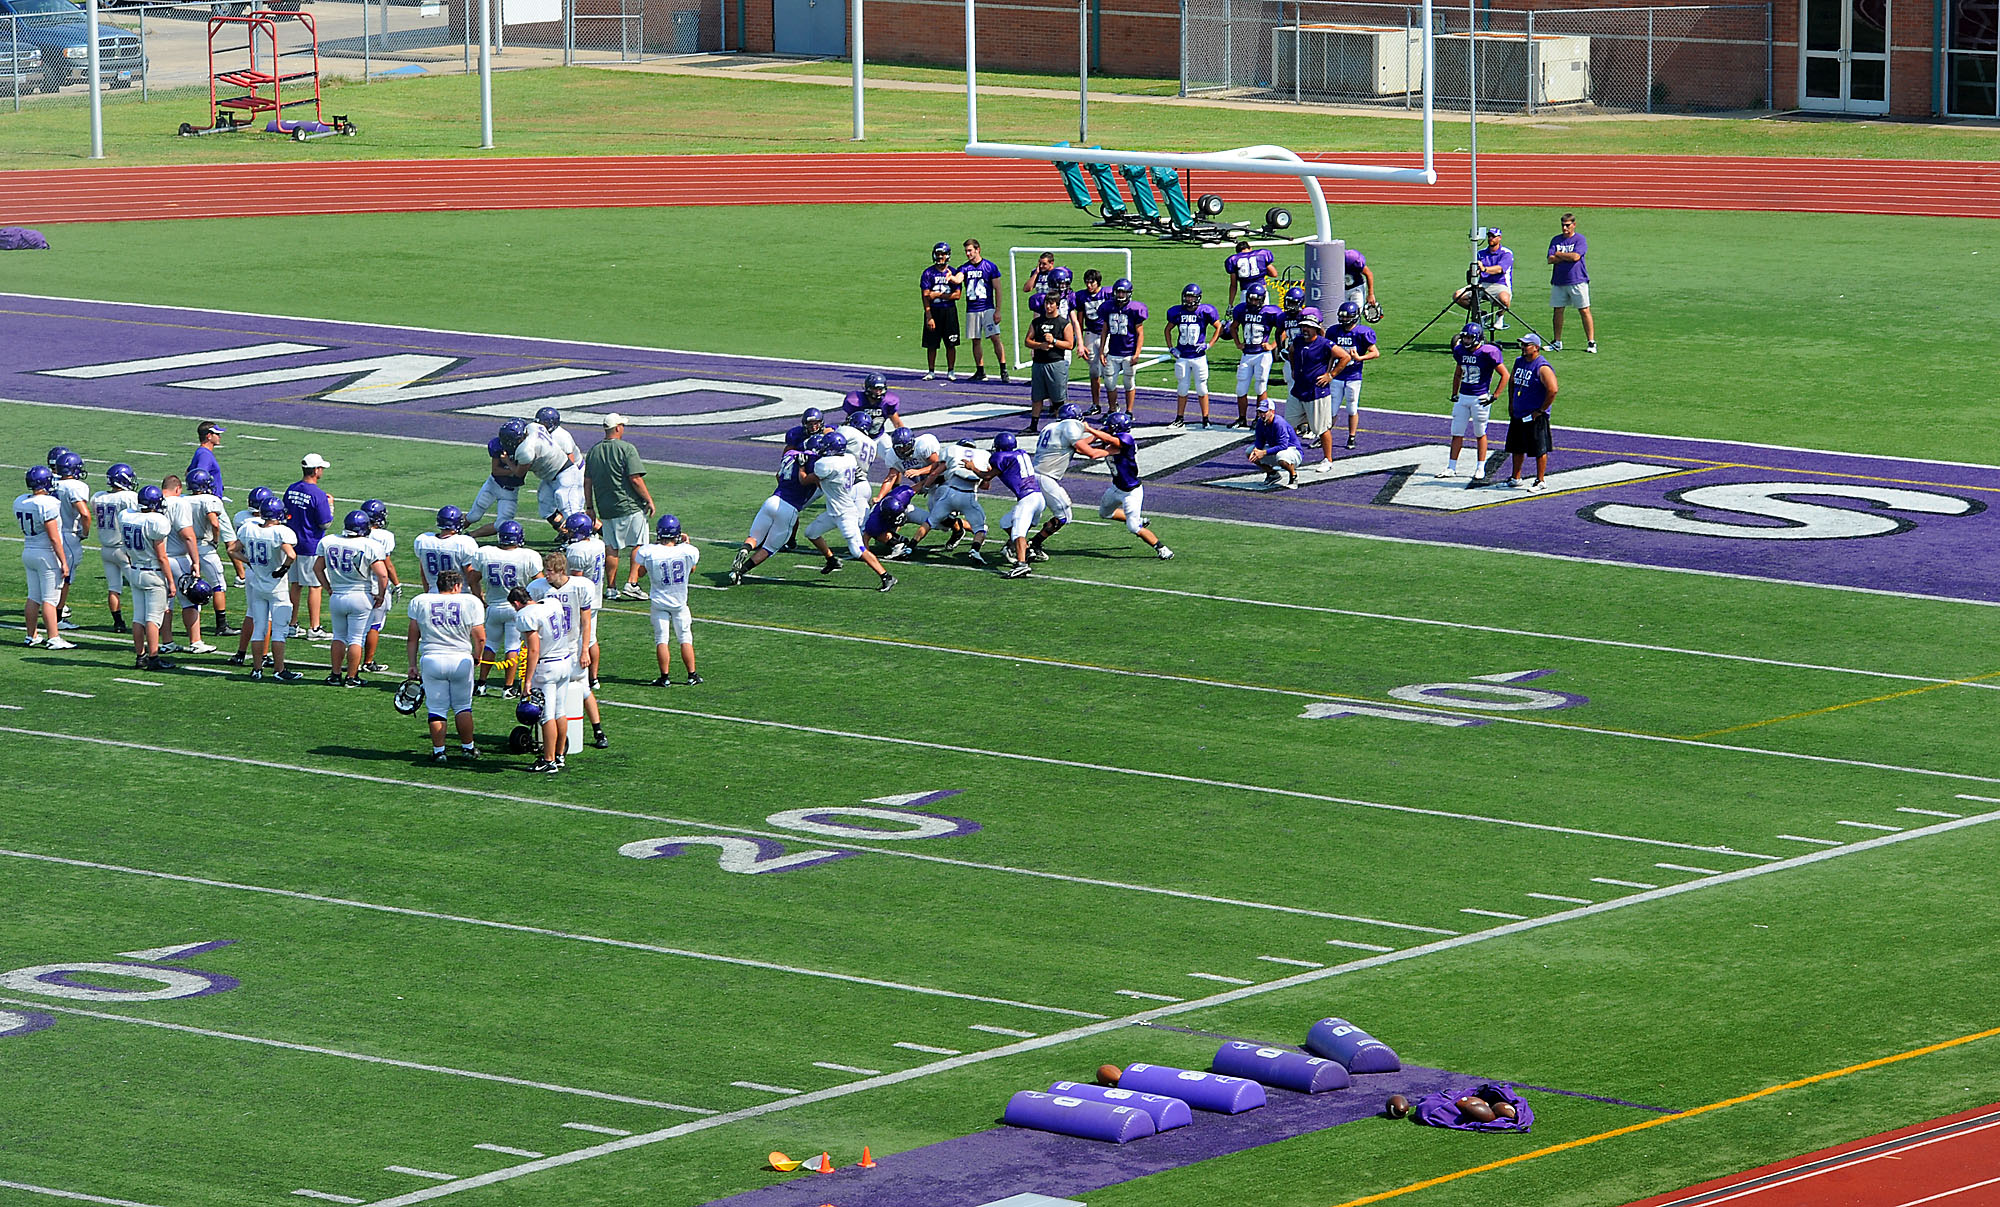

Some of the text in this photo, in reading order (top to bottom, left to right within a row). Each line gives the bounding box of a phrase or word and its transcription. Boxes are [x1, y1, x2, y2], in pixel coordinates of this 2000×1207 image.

[1244, 314, 1262, 322] PNG
[1337, 337, 1353, 346] PNG
[1462, 355, 1477, 364] PNG
[1514, 367, 1533, 380] PNG
[16, 511, 38, 536] 77
[123, 525, 147, 551] 50
[249, 539, 269, 566] 13
[487, 562, 518, 588] 52
[661, 560, 685, 586] 12
[430, 601, 461, 628] 53
[1297, 682, 1590, 727] 10
[618, 806, 983, 875] 20
